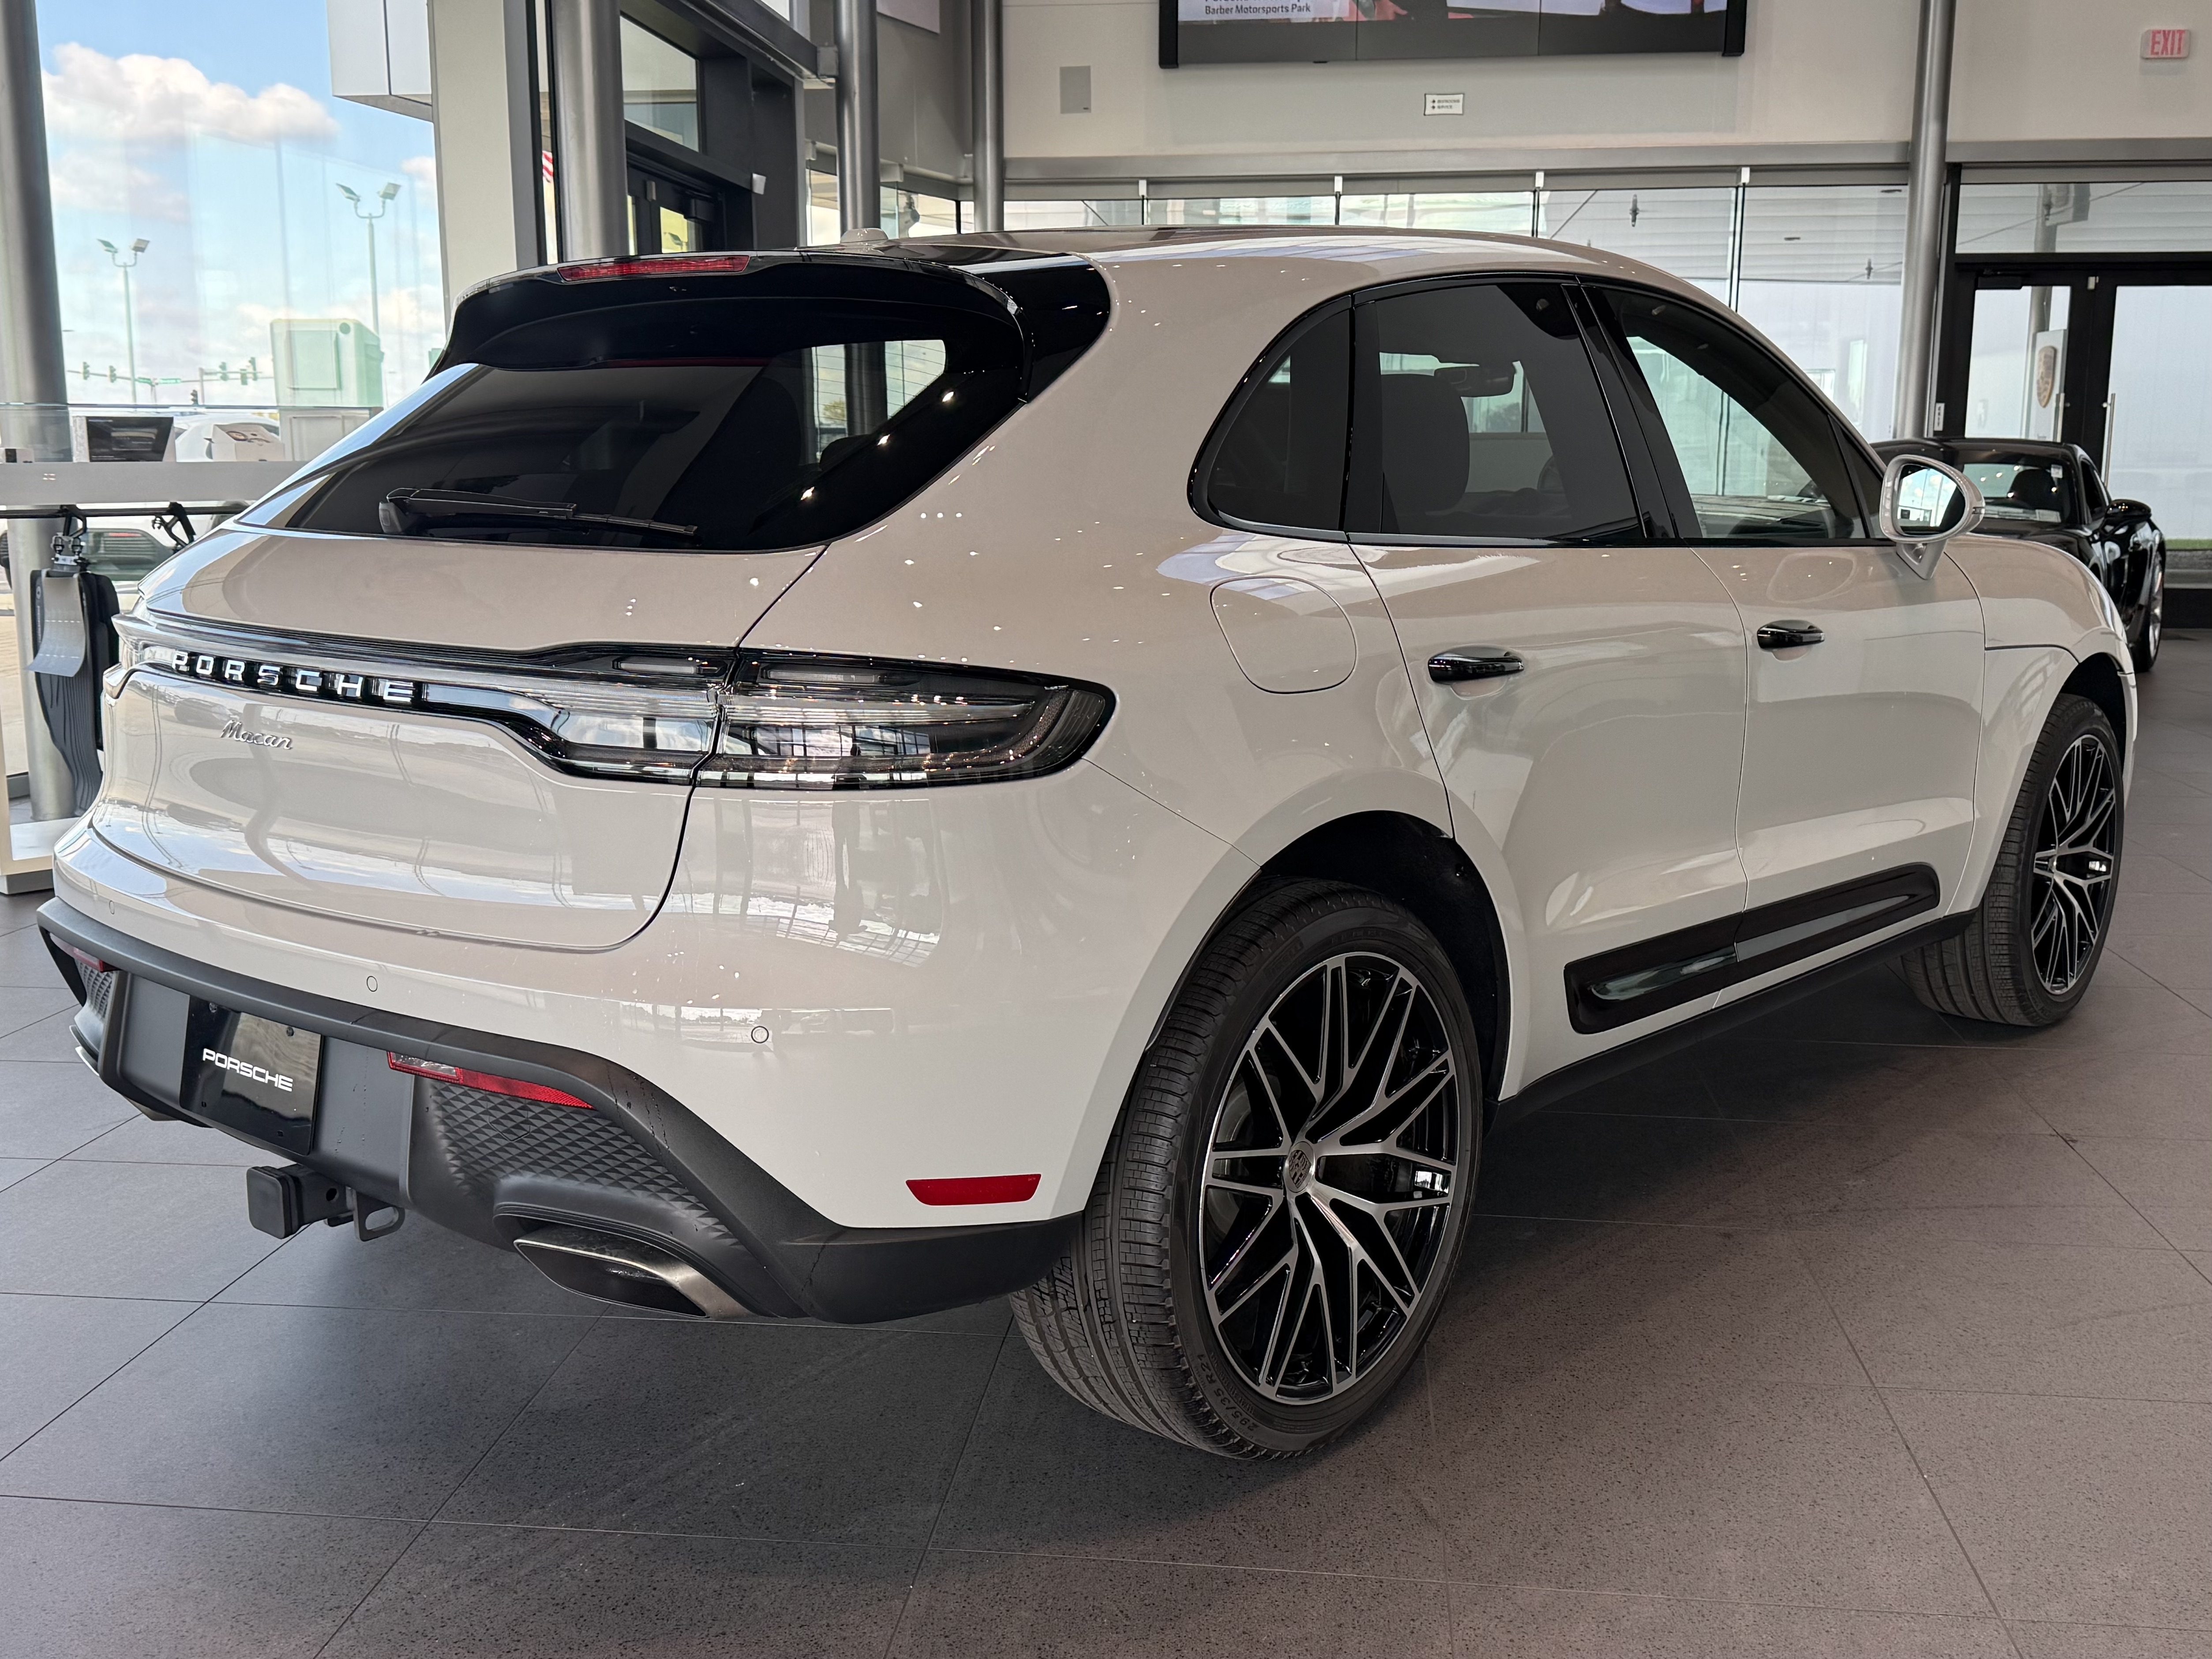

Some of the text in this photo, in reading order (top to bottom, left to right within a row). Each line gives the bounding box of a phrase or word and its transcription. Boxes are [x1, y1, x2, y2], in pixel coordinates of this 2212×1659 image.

[1205, 3, 1310, 14] Barber Motorsports Park
[2151, 29, 2186, 55] EXIT
[172, 651, 414, 703] PORSCHE
[220, 719, 293, 750] Macan
[202, 1048, 293, 1092] PORSCHE
[1214, 1388, 1260, 1432] 295/35
